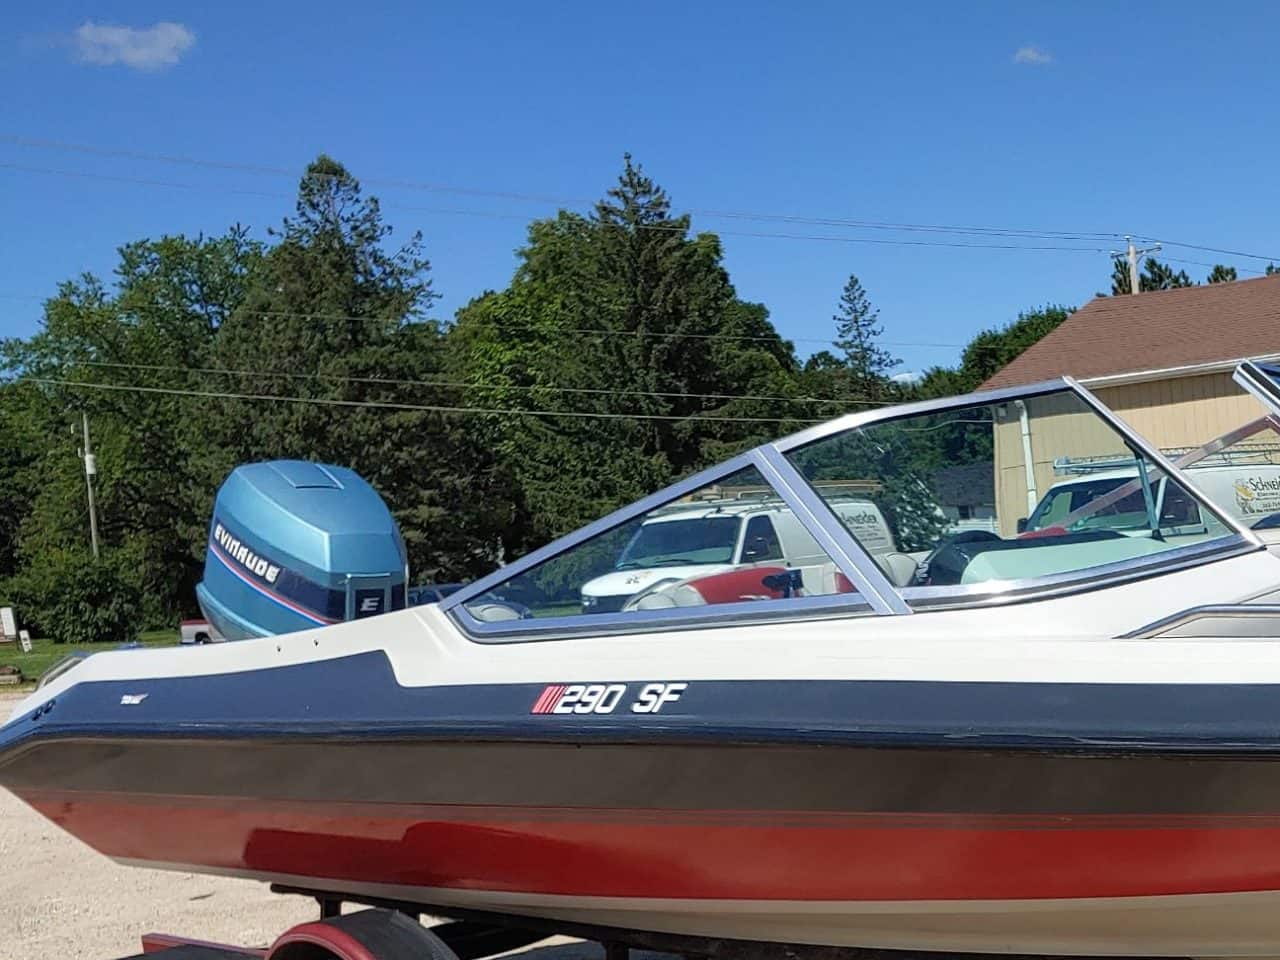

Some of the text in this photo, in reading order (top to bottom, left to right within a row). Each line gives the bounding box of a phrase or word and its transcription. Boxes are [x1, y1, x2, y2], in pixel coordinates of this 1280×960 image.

[213, 523, 281, 583] EVINRUDE
[553, 682, 689, 714] 290 SF
